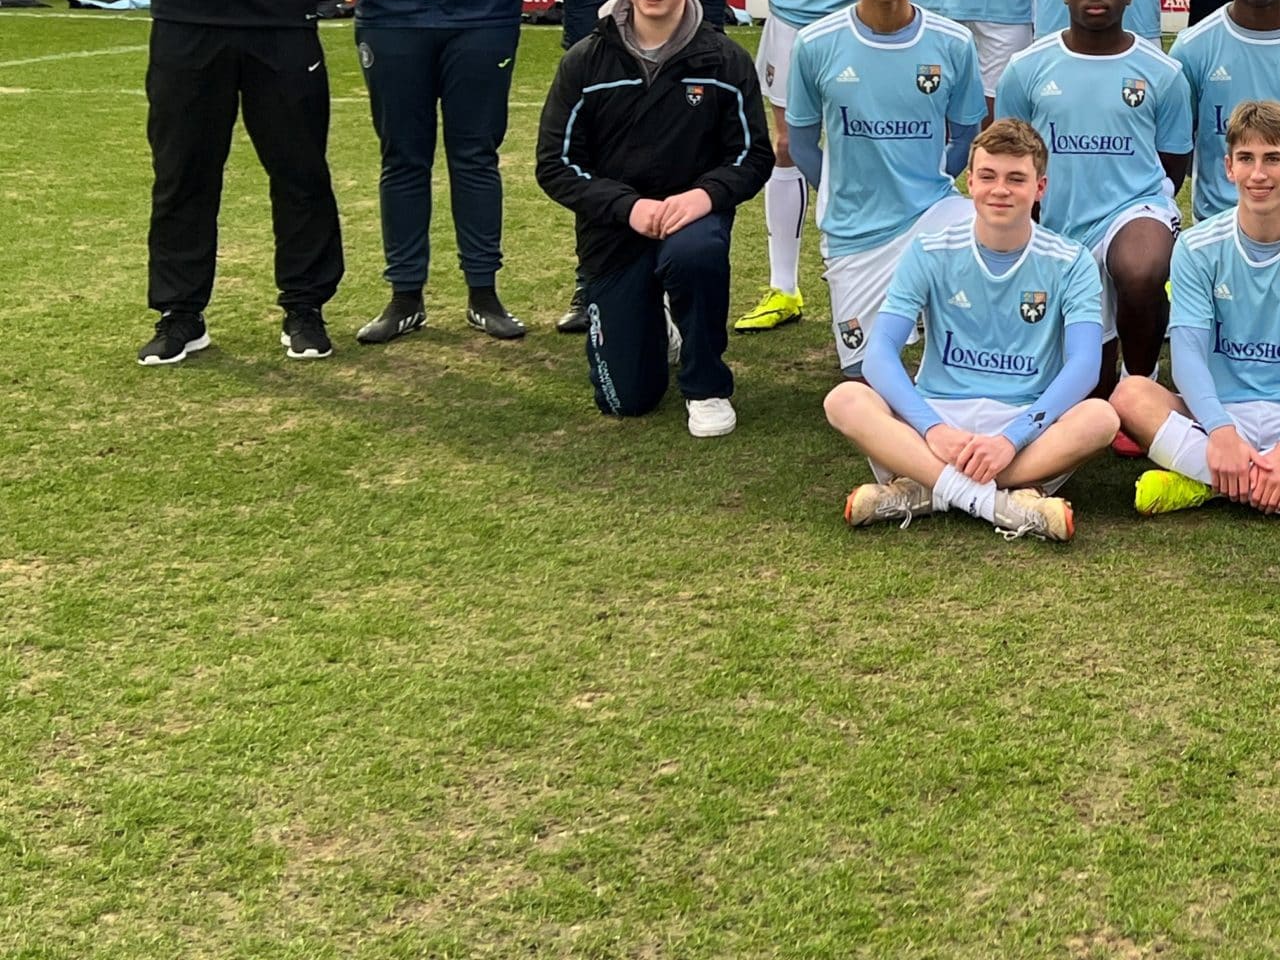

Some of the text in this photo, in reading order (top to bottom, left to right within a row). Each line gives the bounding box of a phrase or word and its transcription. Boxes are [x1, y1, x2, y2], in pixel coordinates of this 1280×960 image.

[839, 106, 933, 140] LONGSHOT
[1049, 121, 1135, 156] LONGSHOT
[942, 330, 1039, 376] LONGSHOT
